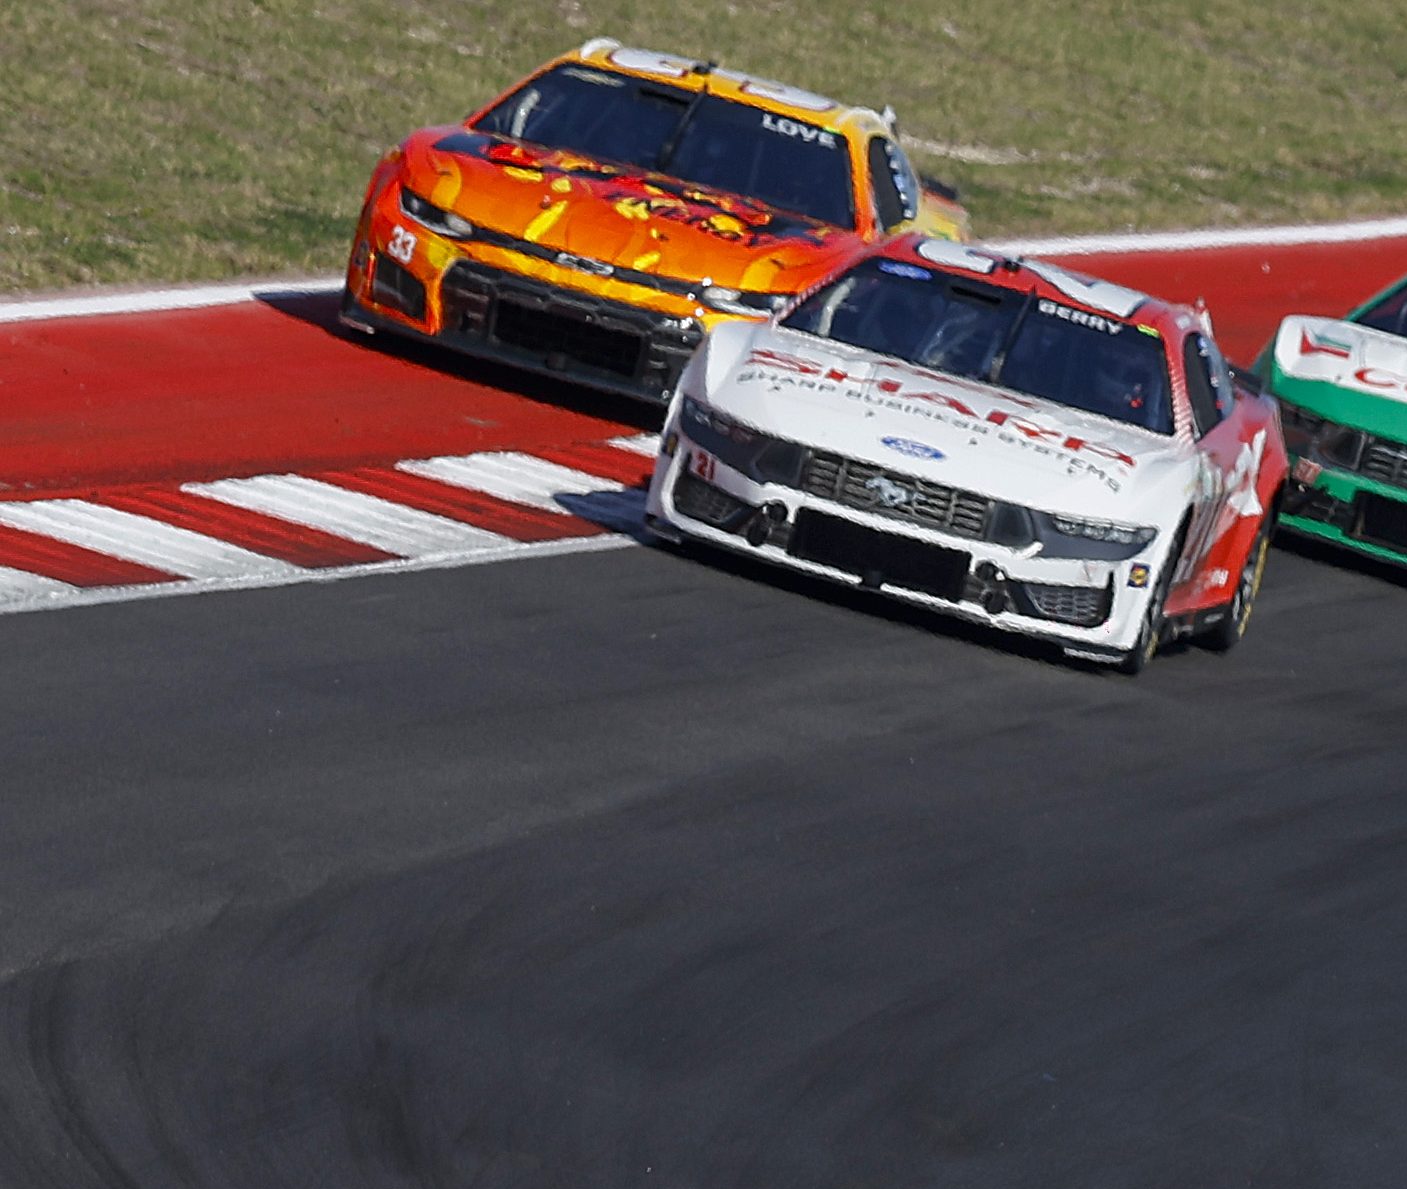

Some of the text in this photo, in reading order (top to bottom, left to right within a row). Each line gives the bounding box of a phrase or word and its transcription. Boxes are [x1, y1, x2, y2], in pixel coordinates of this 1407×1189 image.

[763, 113, 838, 150] LOVE
[388, 224, 417, 264] 33
[1039, 299, 1123, 335] BERRY
[745, 350, 1135, 467] SHARP
[736, 370, 1122, 494] SHARP BUSINESS SYSTEMS
[696, 451, 716, 480] 21
